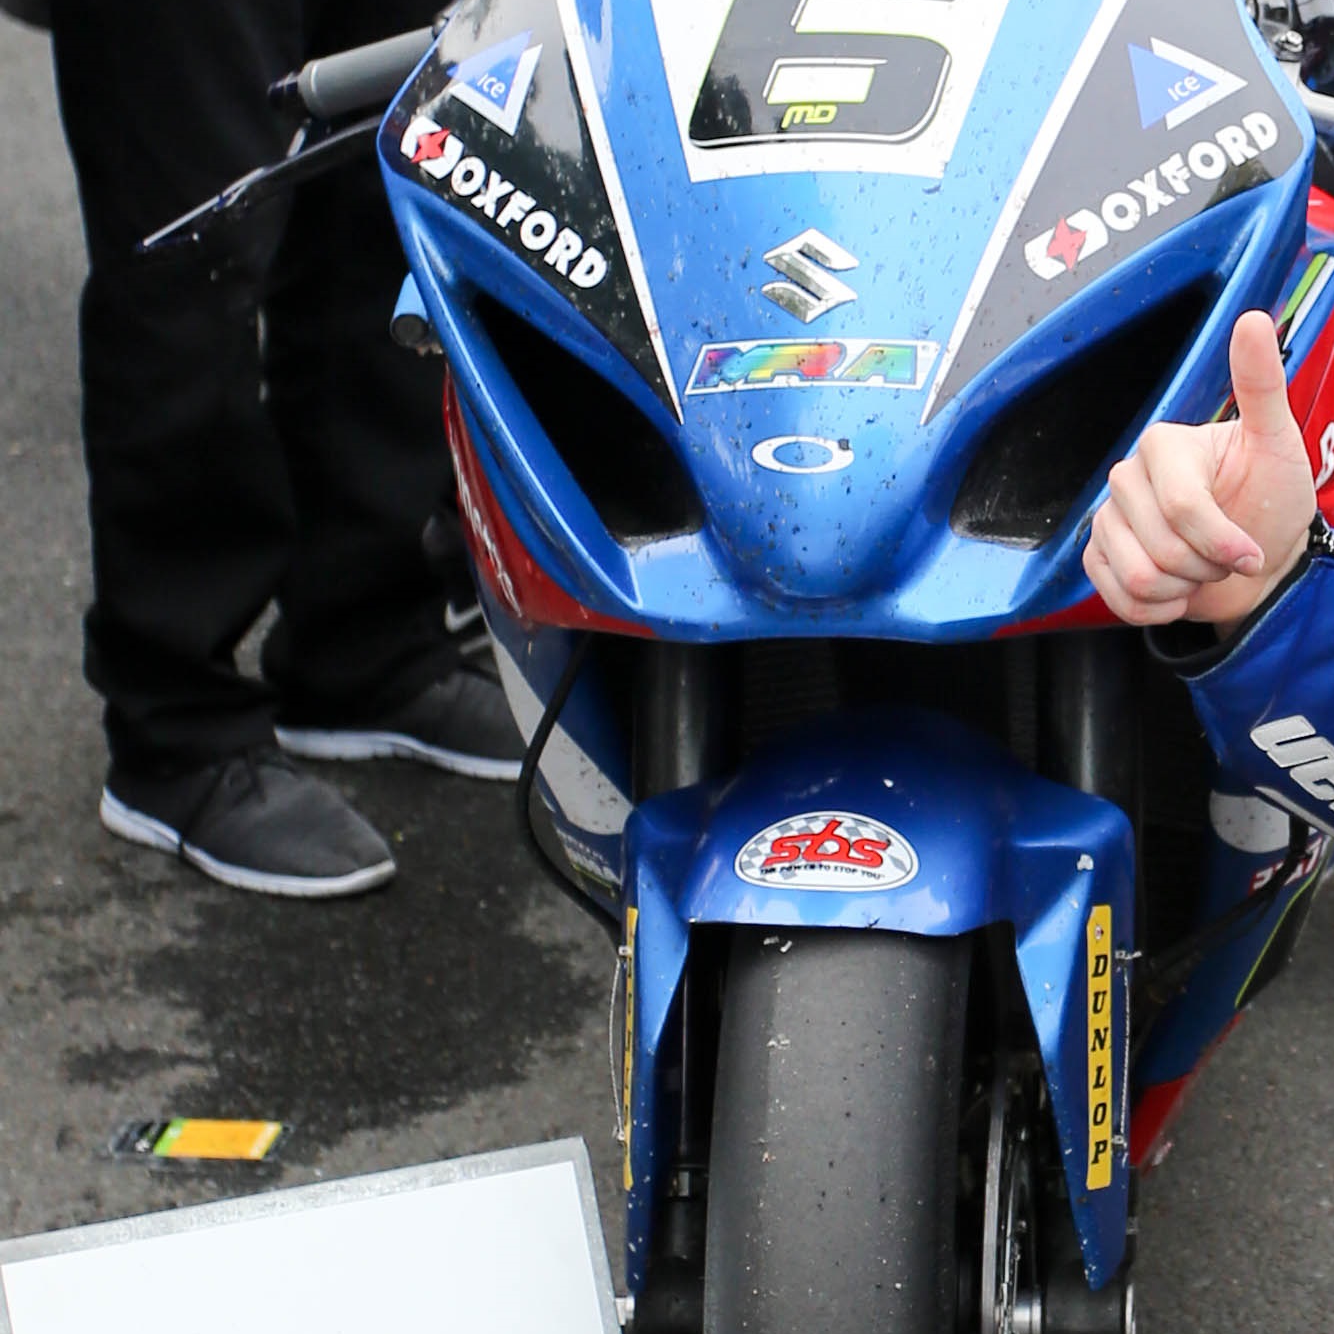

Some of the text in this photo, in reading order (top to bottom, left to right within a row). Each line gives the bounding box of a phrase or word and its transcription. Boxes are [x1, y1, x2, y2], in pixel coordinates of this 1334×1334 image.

[451, 156, 608, 289] OXFORD
[1100, 111, 1279, 232] OXFORD
[763, 819, 890, 868] sbs
[834, 866, 858, 874] STOP
[861, 870, 881, 879] YOU
[1090, 955, 1110, 1167] DUNLOP
